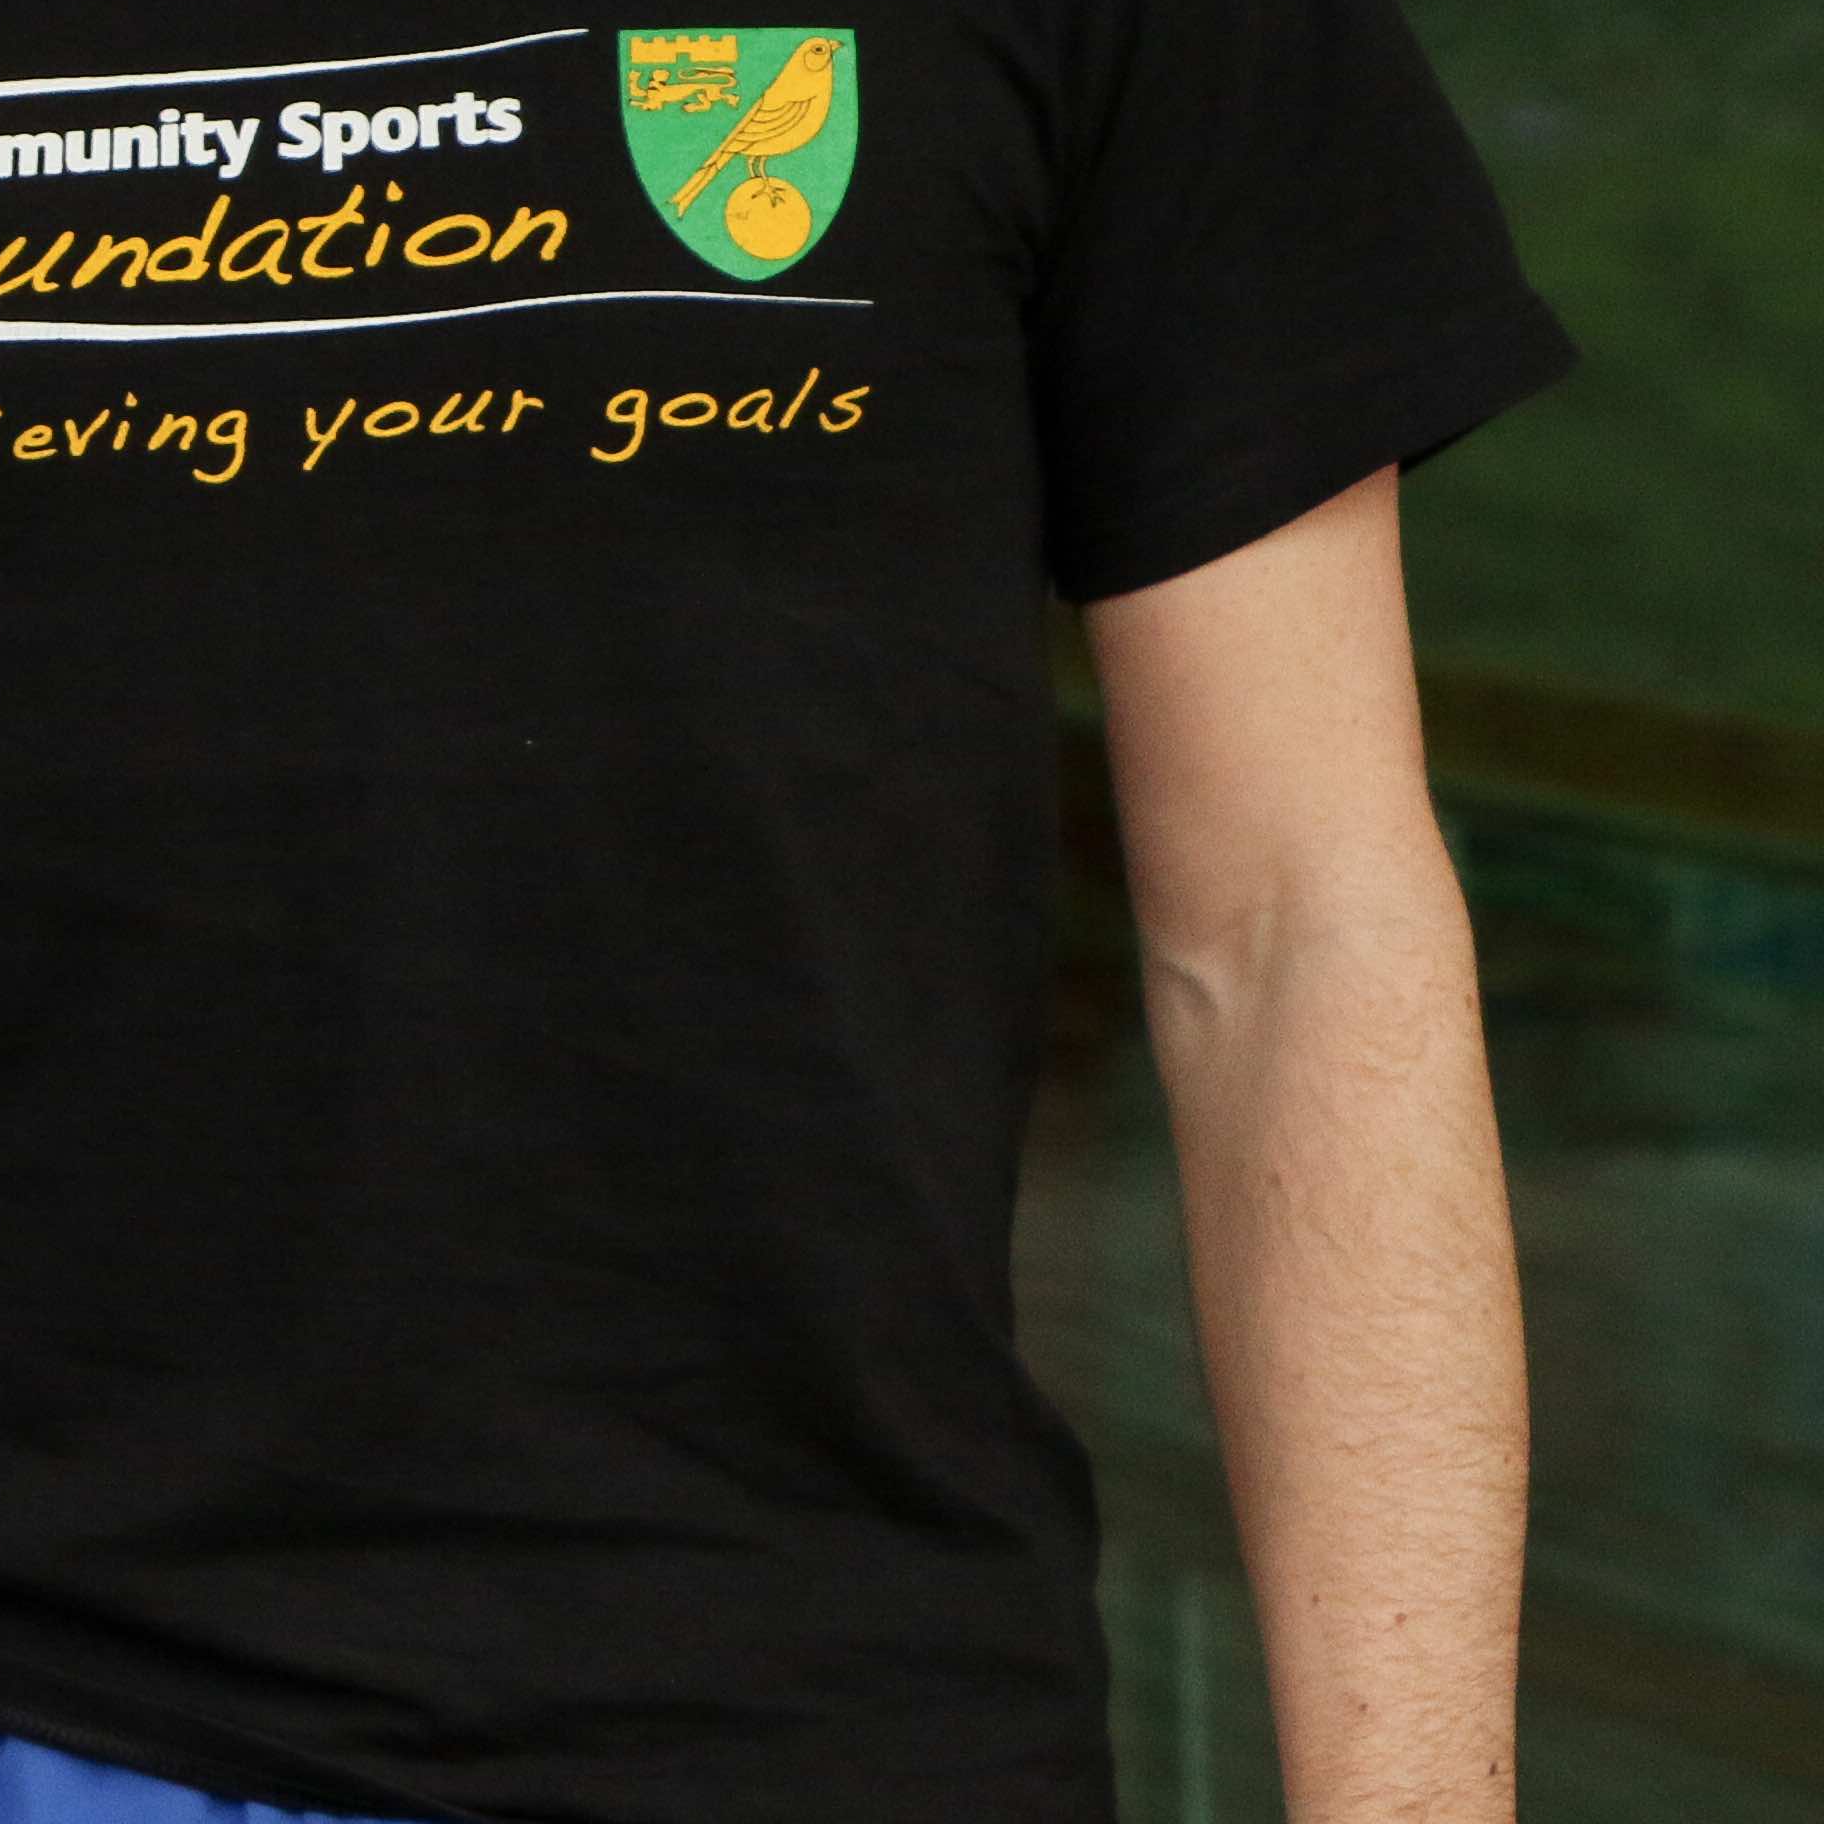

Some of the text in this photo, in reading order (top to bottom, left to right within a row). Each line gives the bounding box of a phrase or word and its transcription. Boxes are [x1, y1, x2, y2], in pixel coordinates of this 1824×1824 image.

[276, 90, 523, 160] Sports
[301, 387, 546, 472] your
[590, 367, 874, 464] goals
